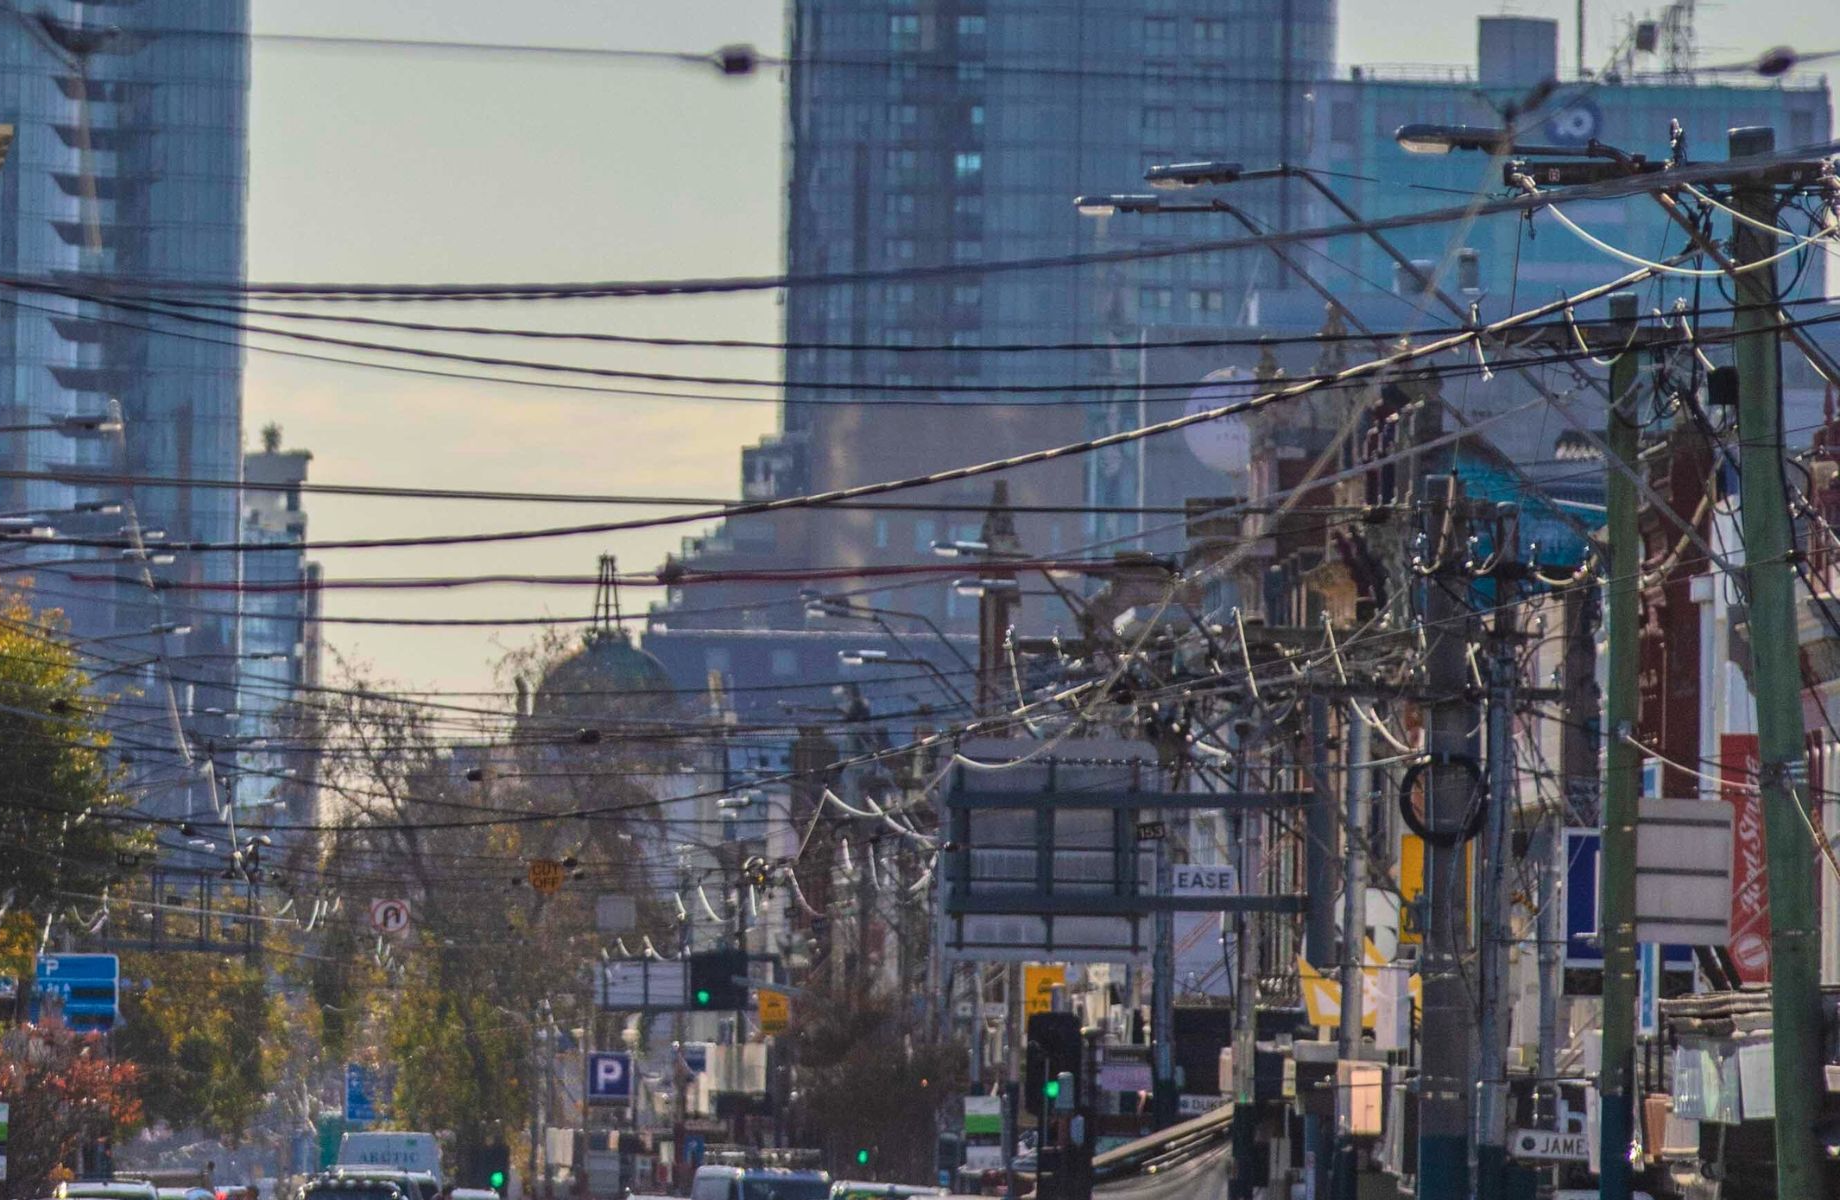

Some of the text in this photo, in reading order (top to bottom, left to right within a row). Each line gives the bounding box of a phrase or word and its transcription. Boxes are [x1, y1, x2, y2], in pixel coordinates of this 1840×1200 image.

[1171, 872, 1231, 890] EASE
[46, 960, 59, 976] P
[597, 1059, 623, 1092] P
